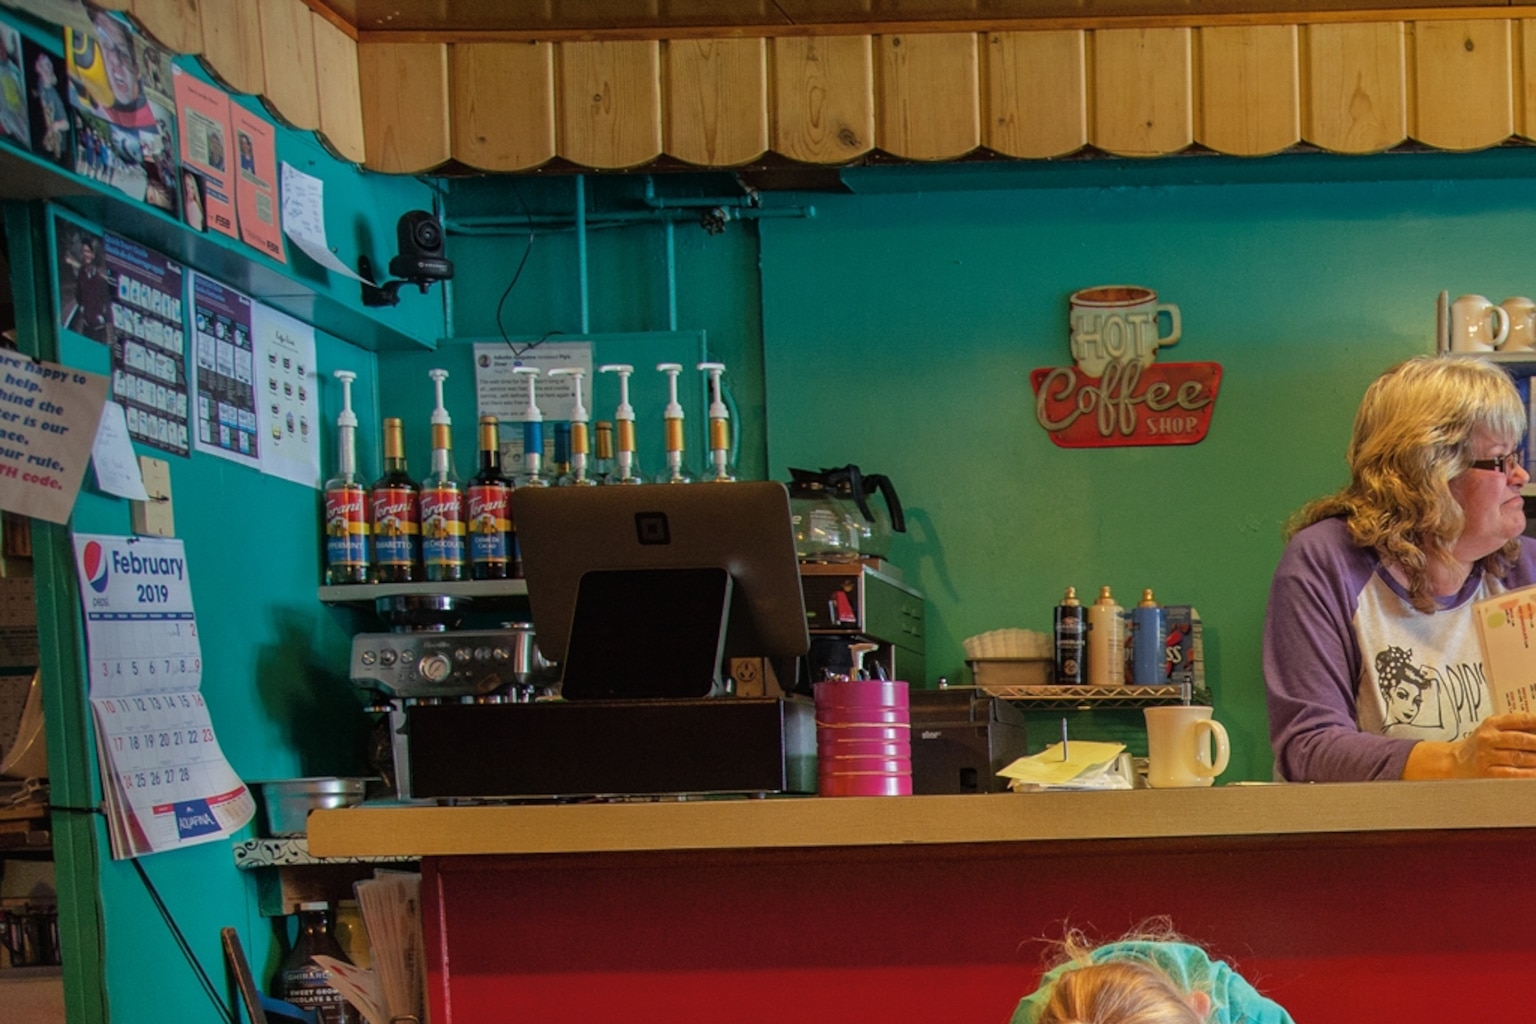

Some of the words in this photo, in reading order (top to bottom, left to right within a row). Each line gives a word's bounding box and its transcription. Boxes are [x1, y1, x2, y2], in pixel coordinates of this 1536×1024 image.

[1075, 313, 1149, 360] HOT
[25, 361, 69, 383] happy
[72, 374, 87, 385] to
[5, 374, 42, 393] help.
[1037, 359, 1211, 436] Coffee
[39, 400, 64, 416] the
[0, 409, 20, 422] er
[23, 415, 37, 428] is
[41, 422, 69, 435] our
[1147, 416, 1198, 435] SHOP
[27, 455, 64, 472] rule.
[22, 472, 62, 490] code.
[326, 499, 362, 519] Torani
[373, 498, 413, 517] Torani
[421, 495, 461, 517] Torani
[468, 495, 508, 515] Torani
[112, 550, 183, 581] February
[136, 584, 168, 603] 2019
[103, 662, 109, 677] 3
[116, 662, 122, 675] 4
[132, 661, 139, 676] 5
[149, 661, 156, 675] 6
[165, 660, 170, 674] 7
[180, 659, 186, 673] 8
[195, 659, 200, 673] 9
[102, 700, 116, 714] 10
[117, 699, 130, 713] 11
[133, 697, 147, 712] 12
[148, 697, 162, 710] 13
[163, 695, 176, 709] 14
[178, 694, 191, 708] 15
[192, 694, 204, 707] 16
[113, 737, 123, 751] 17
[129, 736, 140, 750] 18
[144, 734, 154, 748] 19
[159, 733, 170, 747] 20
[174, 732, 183, 746] 21
[188, 730, 199, 744] 22
[202, 728, 214, 742] 23
[123, 775, 133, 790] 24
[135, 773, 146, 788] 25
[151, 771, 161, 786] 26
[165, 769, 175, 784] 27
[179, 768, 190, 782] 28
[179, 812, 215, 831] AQUAFINA
